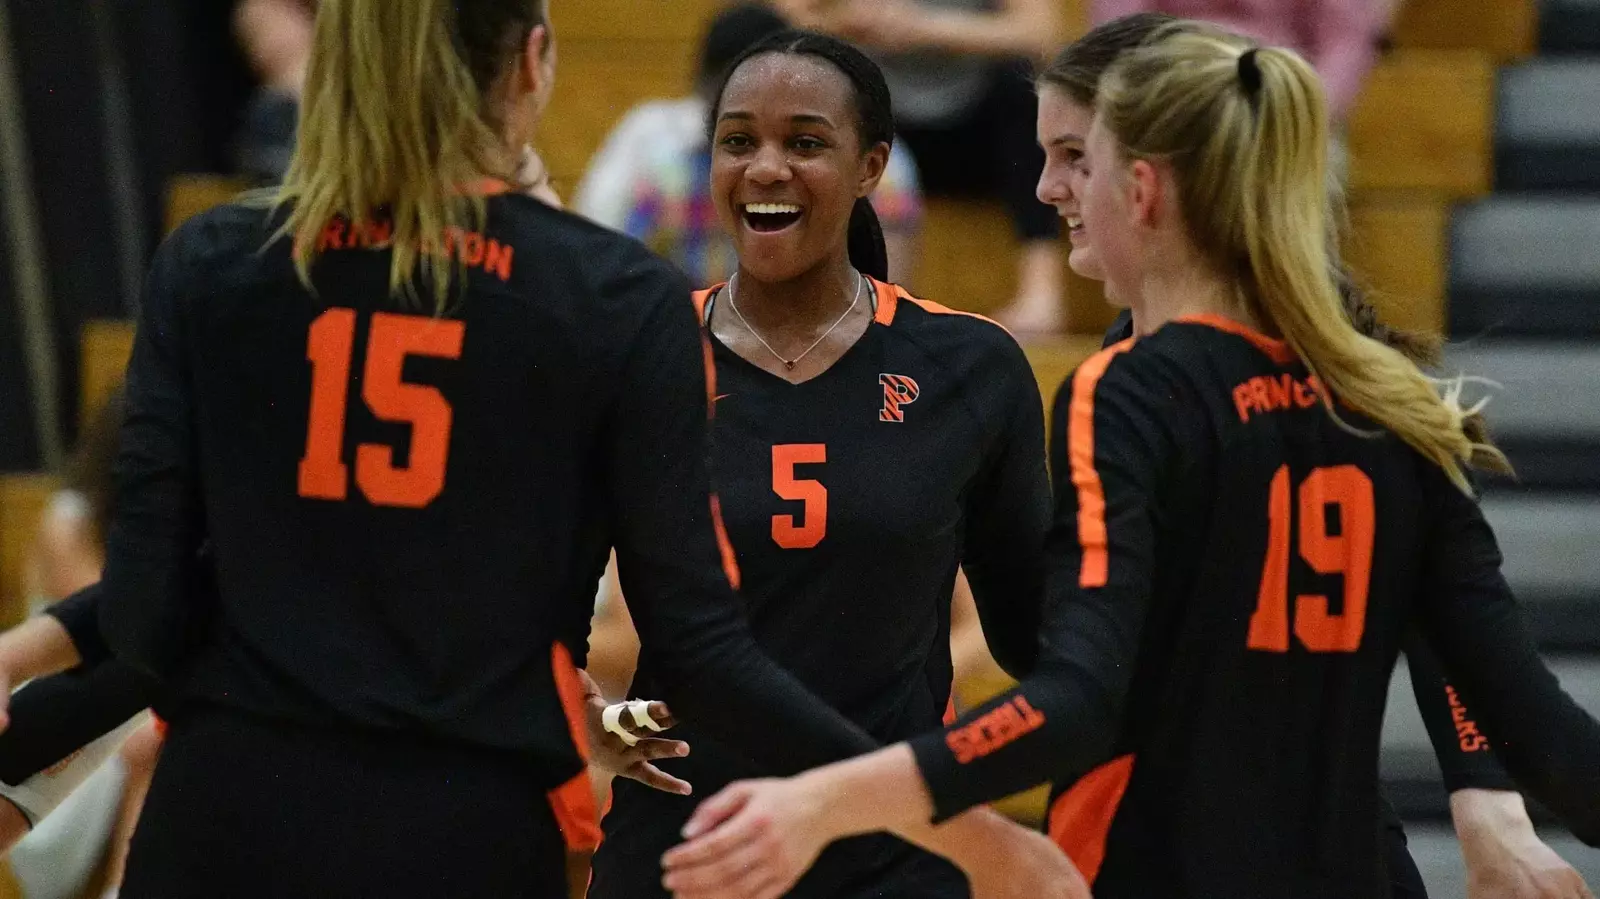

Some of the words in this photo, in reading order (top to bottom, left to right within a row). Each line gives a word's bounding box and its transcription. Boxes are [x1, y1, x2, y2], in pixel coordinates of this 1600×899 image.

[297, 307, 466, 508] 15
[879, 373, 920, 422] P
[771, 443, 828, 549] 5
[1246, 463, 1376, 653] 19
